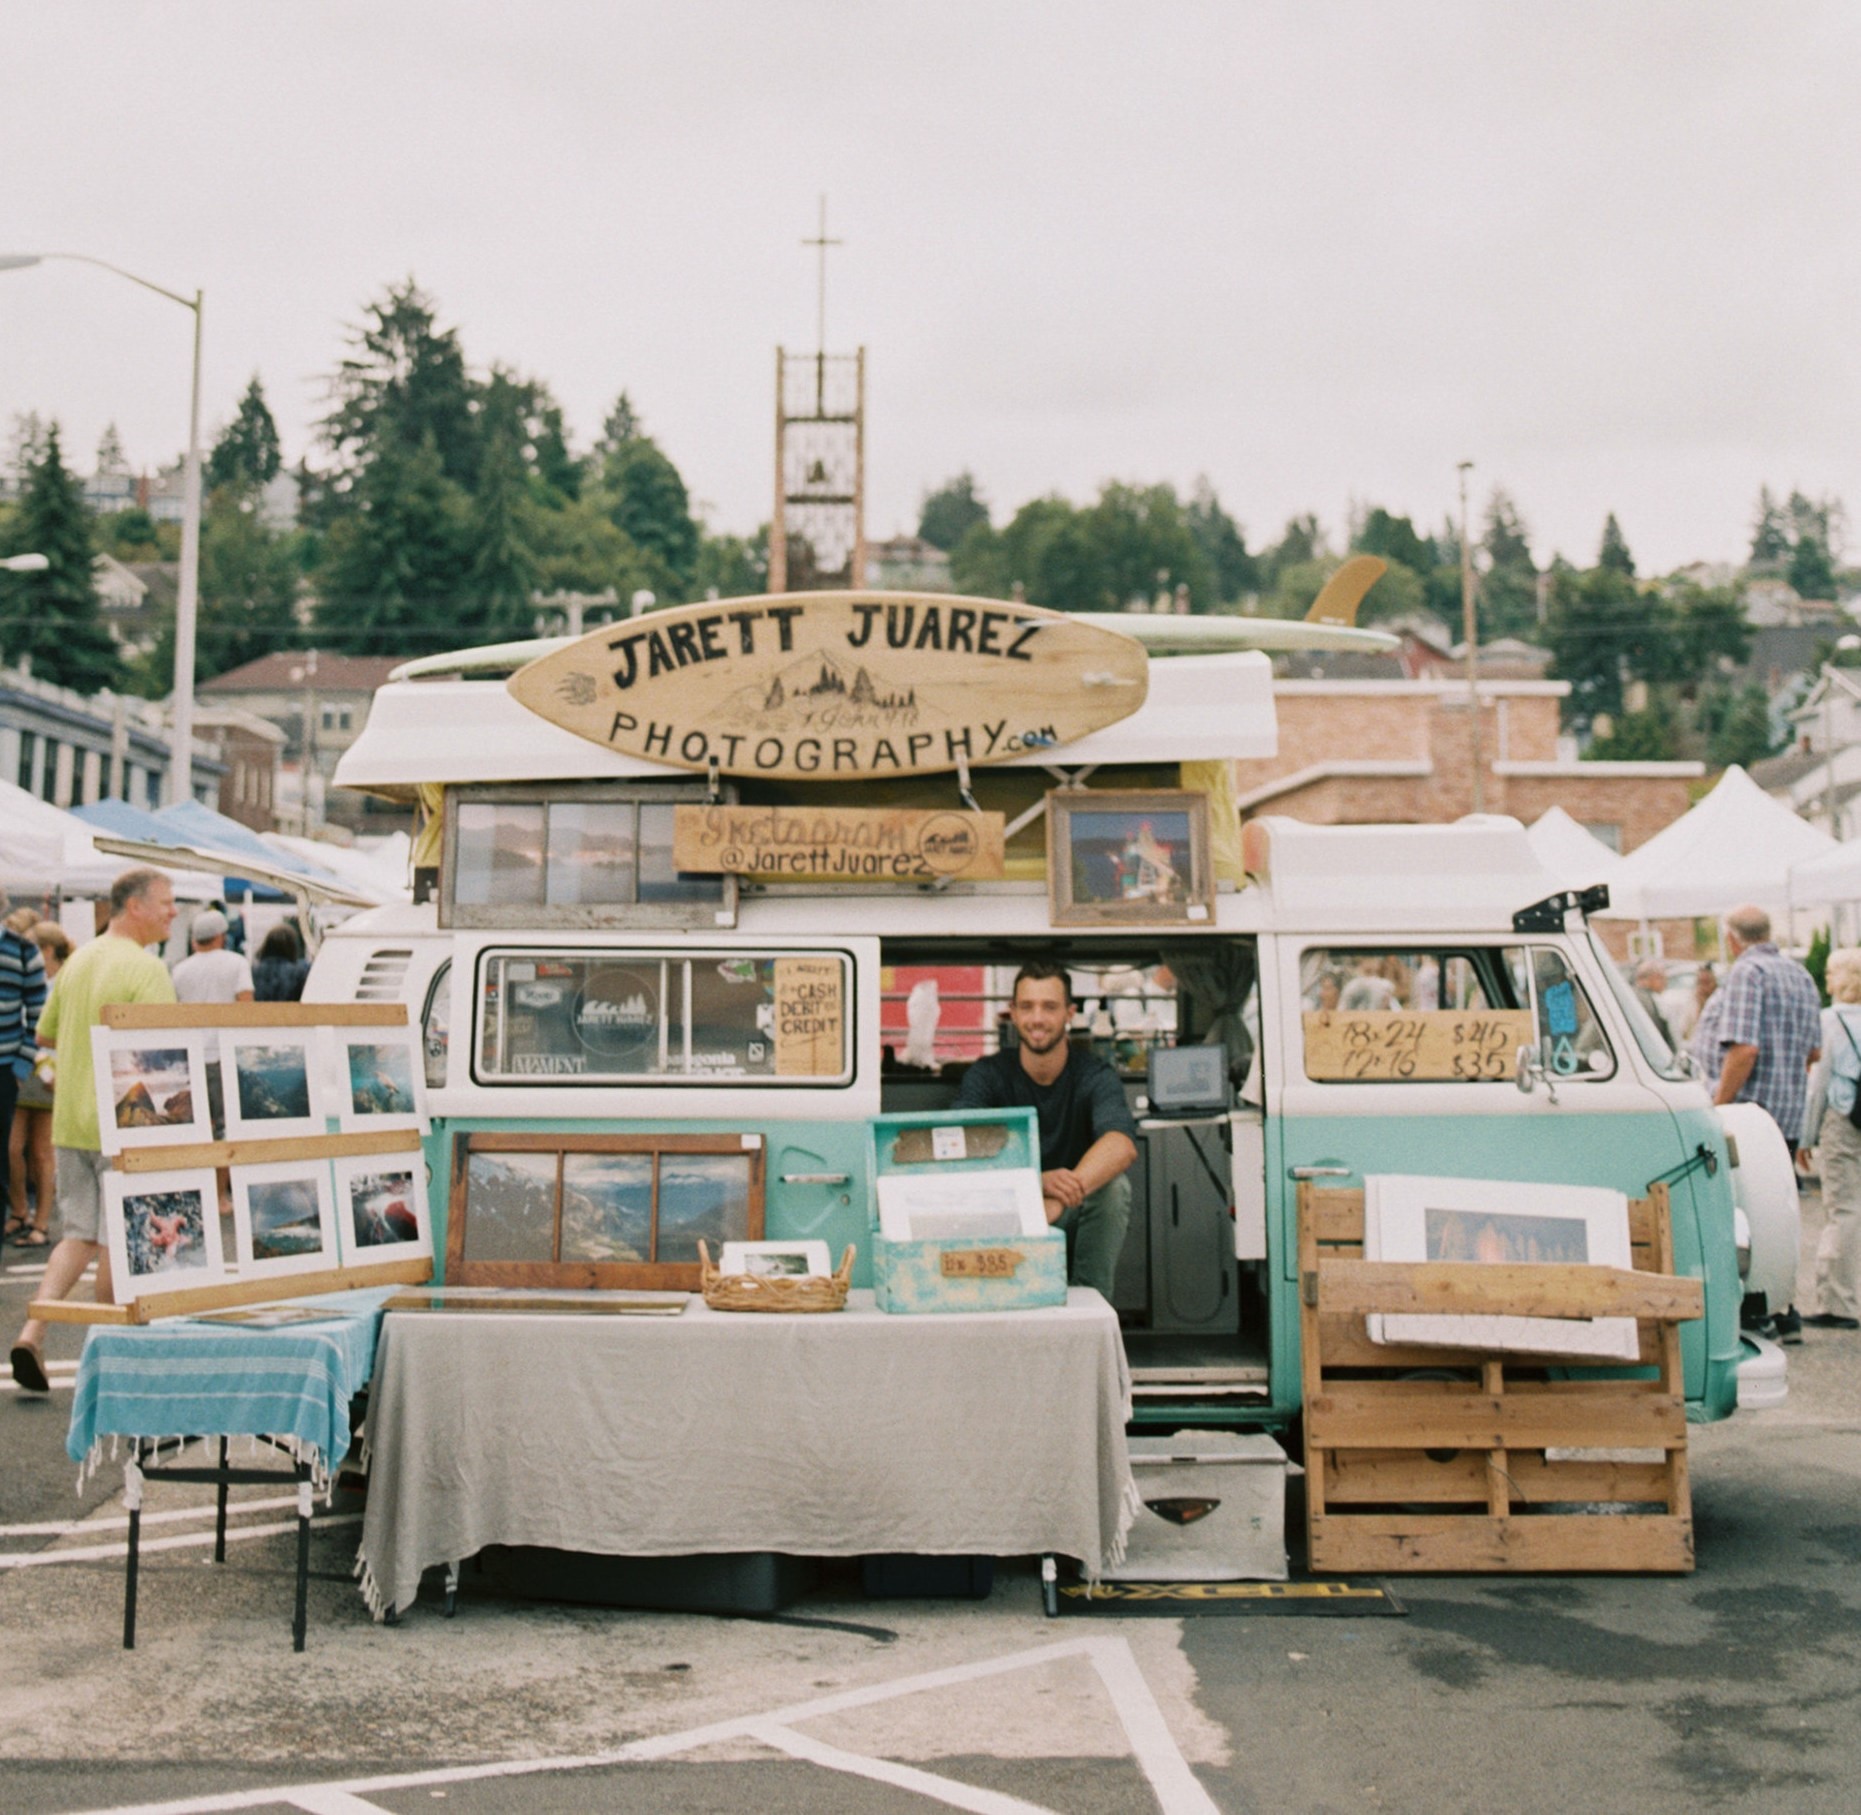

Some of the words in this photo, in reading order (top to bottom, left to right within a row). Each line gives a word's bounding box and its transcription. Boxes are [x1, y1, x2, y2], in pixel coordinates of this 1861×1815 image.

[608, 606, 804, 690] JARETT
[847, 603, 1041, 661] JUAREZ
[797, 983, 837, 999] CASH
[781, 999, 822, 1017] DEBIT
[781, 1017, 838, 1035] CREDIT
[1453, 1021, 1512, 1051] $45
[1452, 1052, 1508, 1077] $35
